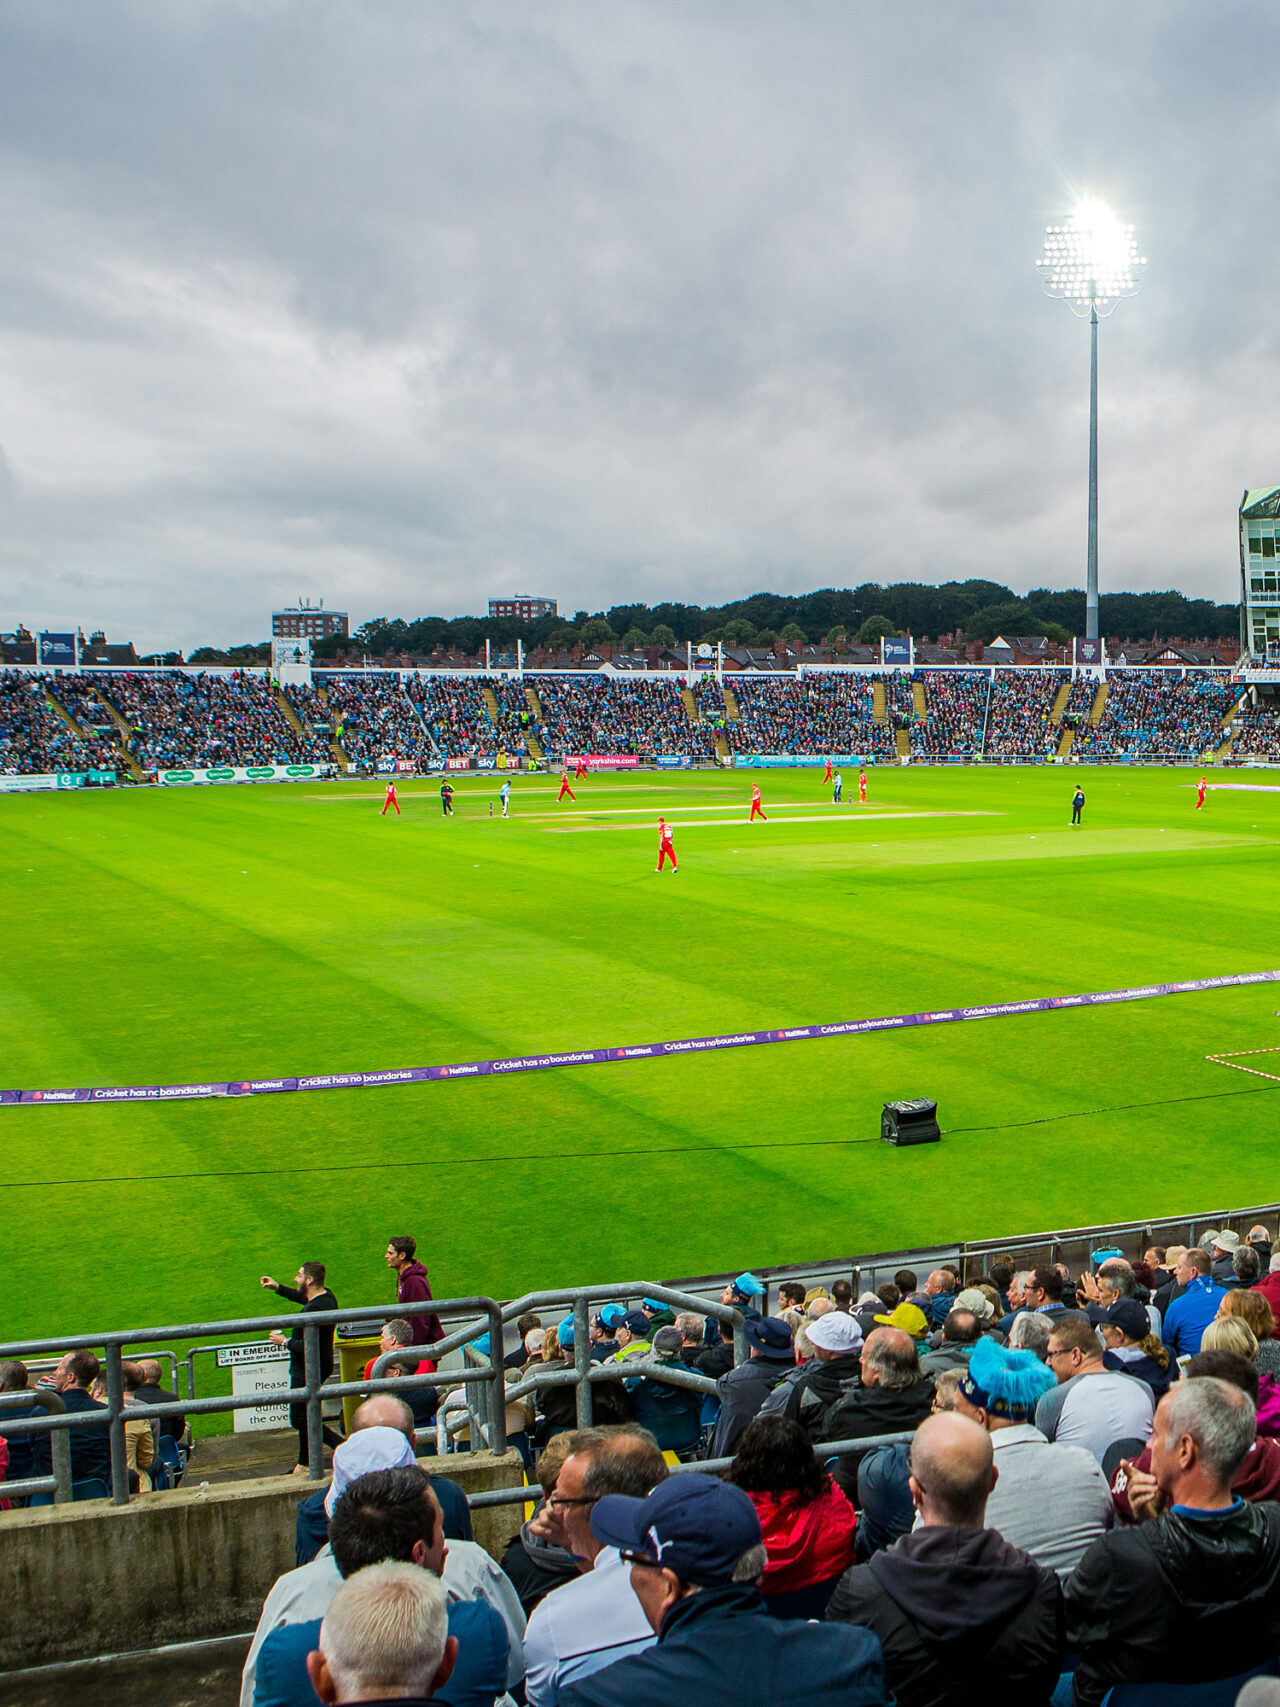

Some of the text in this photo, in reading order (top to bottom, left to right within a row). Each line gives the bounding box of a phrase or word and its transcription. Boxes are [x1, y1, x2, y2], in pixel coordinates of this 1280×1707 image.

[428, 760, 467, 771] sky BET
[478, 759, 495, 770] sky
[588, 757, 637, 765] yorkshire.com
[378, 762, 395, 773] sky
[963, 1008, 986, 1017] Cricket
[986, 1006, 998, 1014] has
[1006, 1002, 1039, 1012] boundaries
[820, 1024, 845, 1034] Cricket
[845, 1023, 859, 1032] has
[859, 1022, 868, 1030] no
[867, 1018, 903, 1029] boundaries
[625, 1047, 653, 1056] NatWest
[664, 1041, 692, 1051] Cricket
[692, 1040, 706, 1049] has
[716, 1035, 756, 1046] boundaries
[493, 1059, 523, 1071] Cricket
[523, 1057, 539, 1067] has
[549, 1052, 595, 1064] boundaries
[449, 1066, 479, 1075] NatWest
[251, 1071, 413, 1090] NatWest Cricket has no boundaries
[43, 1092, 77, 1100] NatWest
[95, 1089, 129, 1098] Cricket
[129, 1089, 147, 1097] has
[159, 1086, 212, 1096] boundaries
[229, 1344, 288, 1357] IN EMERGE
[255, 1380, 288, 1390] Please
[250, 1414, 289, 1424] the ove
